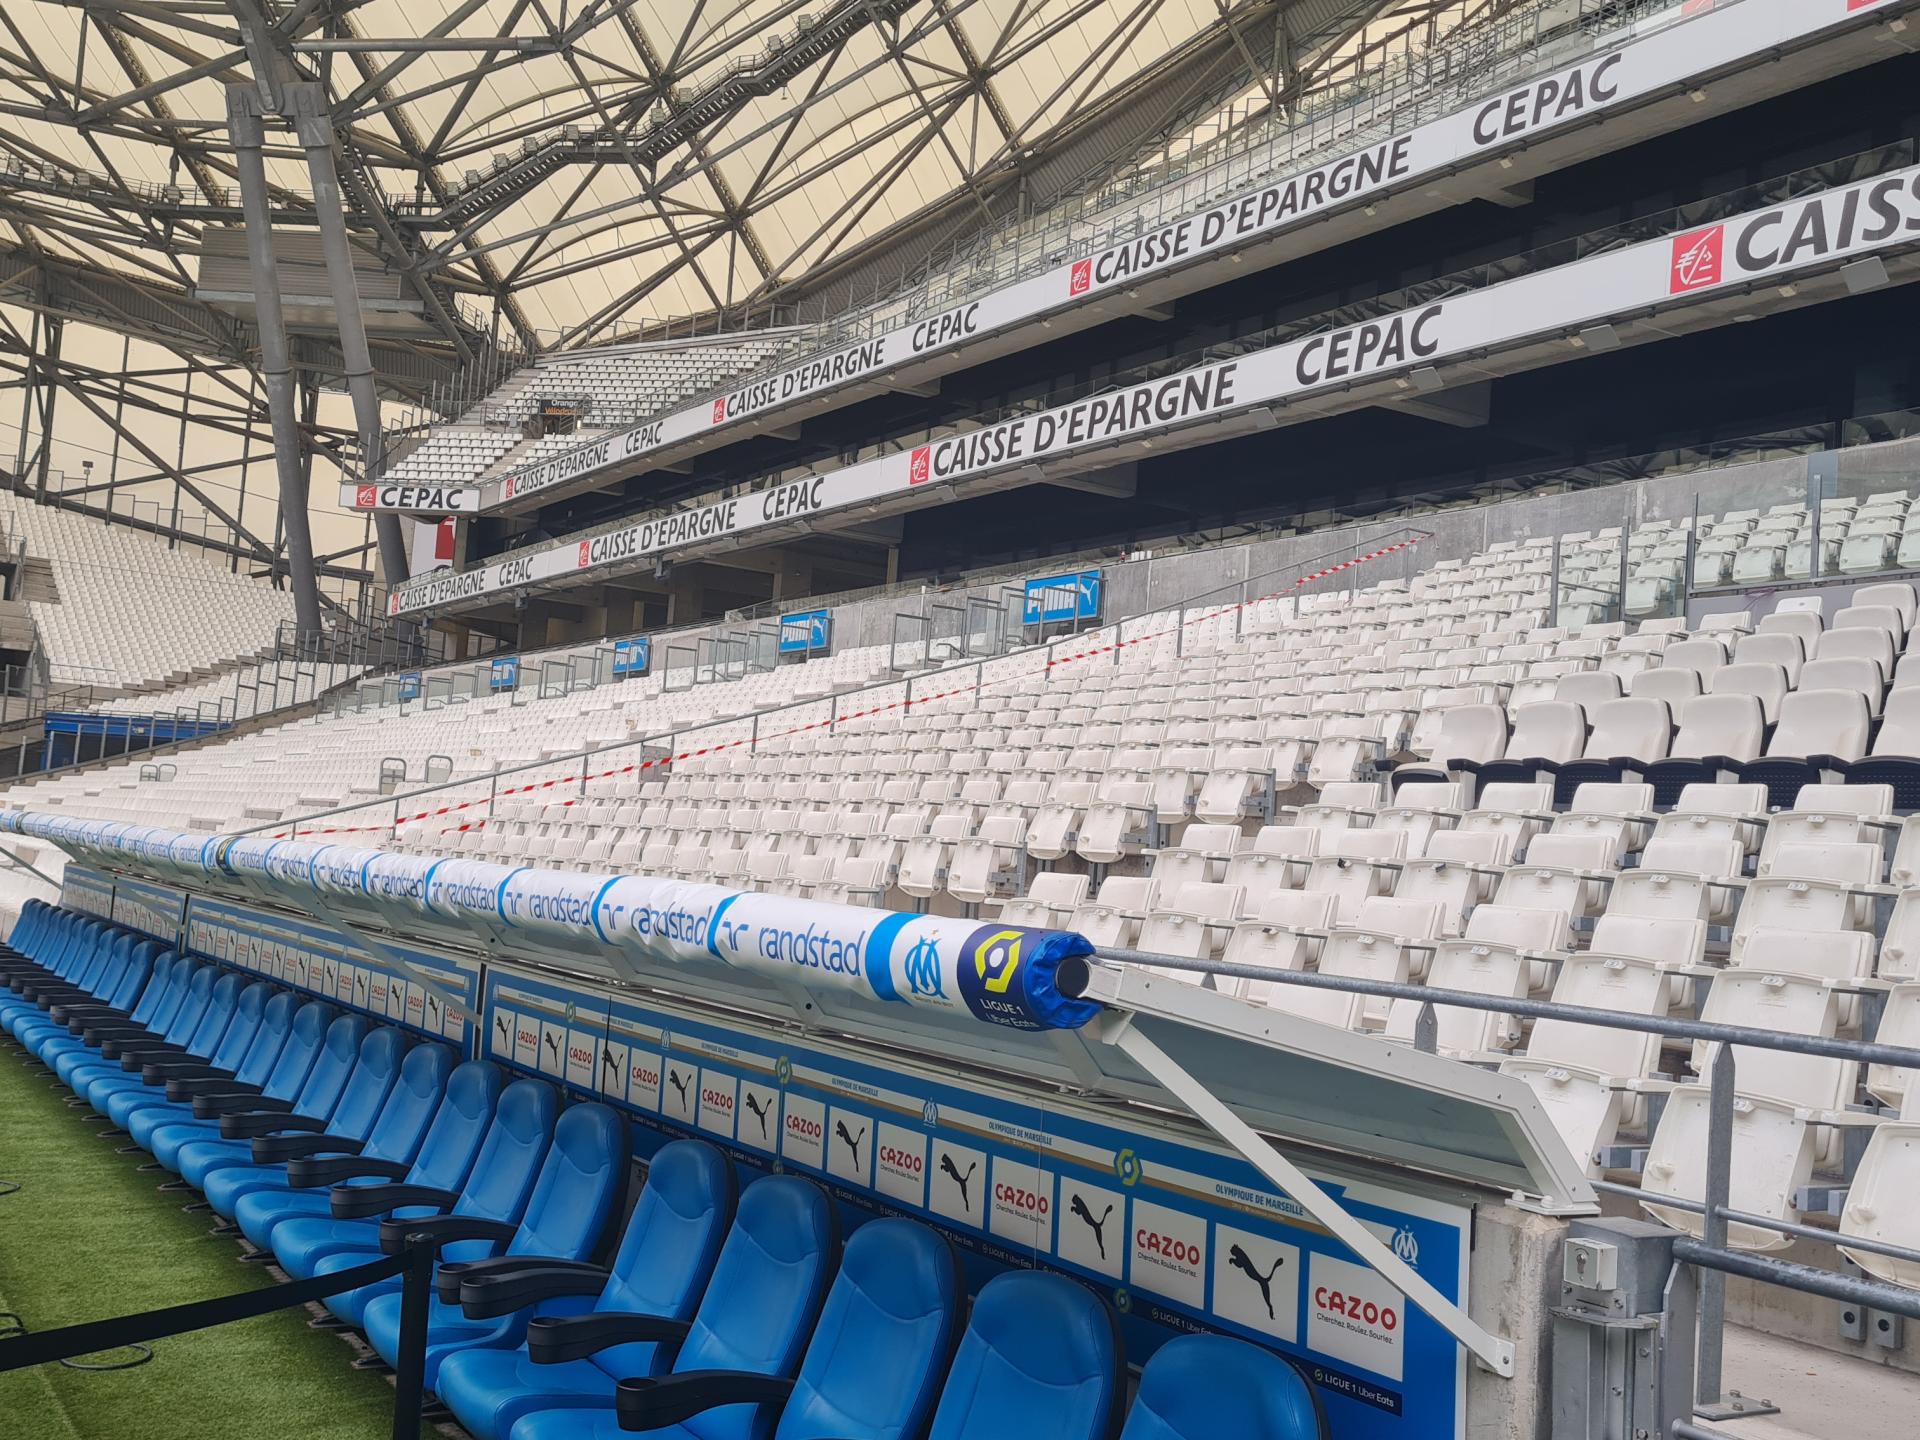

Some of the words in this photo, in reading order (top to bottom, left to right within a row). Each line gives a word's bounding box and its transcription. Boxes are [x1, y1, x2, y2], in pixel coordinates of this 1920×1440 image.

[1095, 220, 1190, 283] CAISSE
[1200, 136, 1413, 245] D'EPARGNE
[1473, 53, 1622, 145] CEPAC
[726, 379, 777, 417] CAISSE
[782, 339, 885, 398] D'EPARGNE
[913, 303, 979, 353] CEPAC
[933, 421, 1022, 477] CAISSE
[1035, 363, 1237, 453] D'EPARGNE
[1295, 305, 1443, 384] CEPAC
[514, 466, 545, 495] CAISSE
[548, 443, 609, 486] D'EPARGNE
[625, 421, 663, 454] CEPAC
[381, 487, 463, 509] CEPAC
[590, 530, 636, 562] CAISSE
[641, 502, 738, 550] D'EPARGNE
[763, 478, 824, 521] CEPAC
[399, 584, 427, 610] CAISSE
[429, 570, 485, 602] D'EPARGNE
[499, 557, 533, 586] CEPAC
[447, 876, 499, 911] randstad
[529, 887, 594, 926] randstad
[631, 901, 712, 945] randstad
[758, 921, 865, 977] randstad
[980, 999, 1015, 1014] LIGUE
[1017, 1006, 1024, 1015] 1
[518, 1030, 537, 1046] CAZOO
[569, 1047, 592, 1064] CAZOO
[632, 1067, 658, 1085] CAZOO
[702, 1088, 733, 1110] CAZOO
[786, 1114, 821, 1138] CAZOO
[989, 1121, 1016, 1136] OLYMPIQUE
[1024, 1131, 1052, 1146] MARSEILLE
[880, 1146, 922, 1172] CAZOO
[996, 1183, 1048, 1214] CAZOO
[1215, 1183, 1254, 1203] OLYMPIQUE
[1255, 1194, 1265, 1206] DE
[1265, 1196, 1303, 1216] MARSEILLE
[1137, 1229, 1200, 1265] CAZOO
[1160, 1311, 1181, 1327] LIGUE
[1315, 1286, 1397, 1330] CAZOO
[1324, 1373, 1350, 1391] LIGUE
[1358, 1386, 1375, 1400] Uber
[1376, 1393, 1394, 1408] Eats
